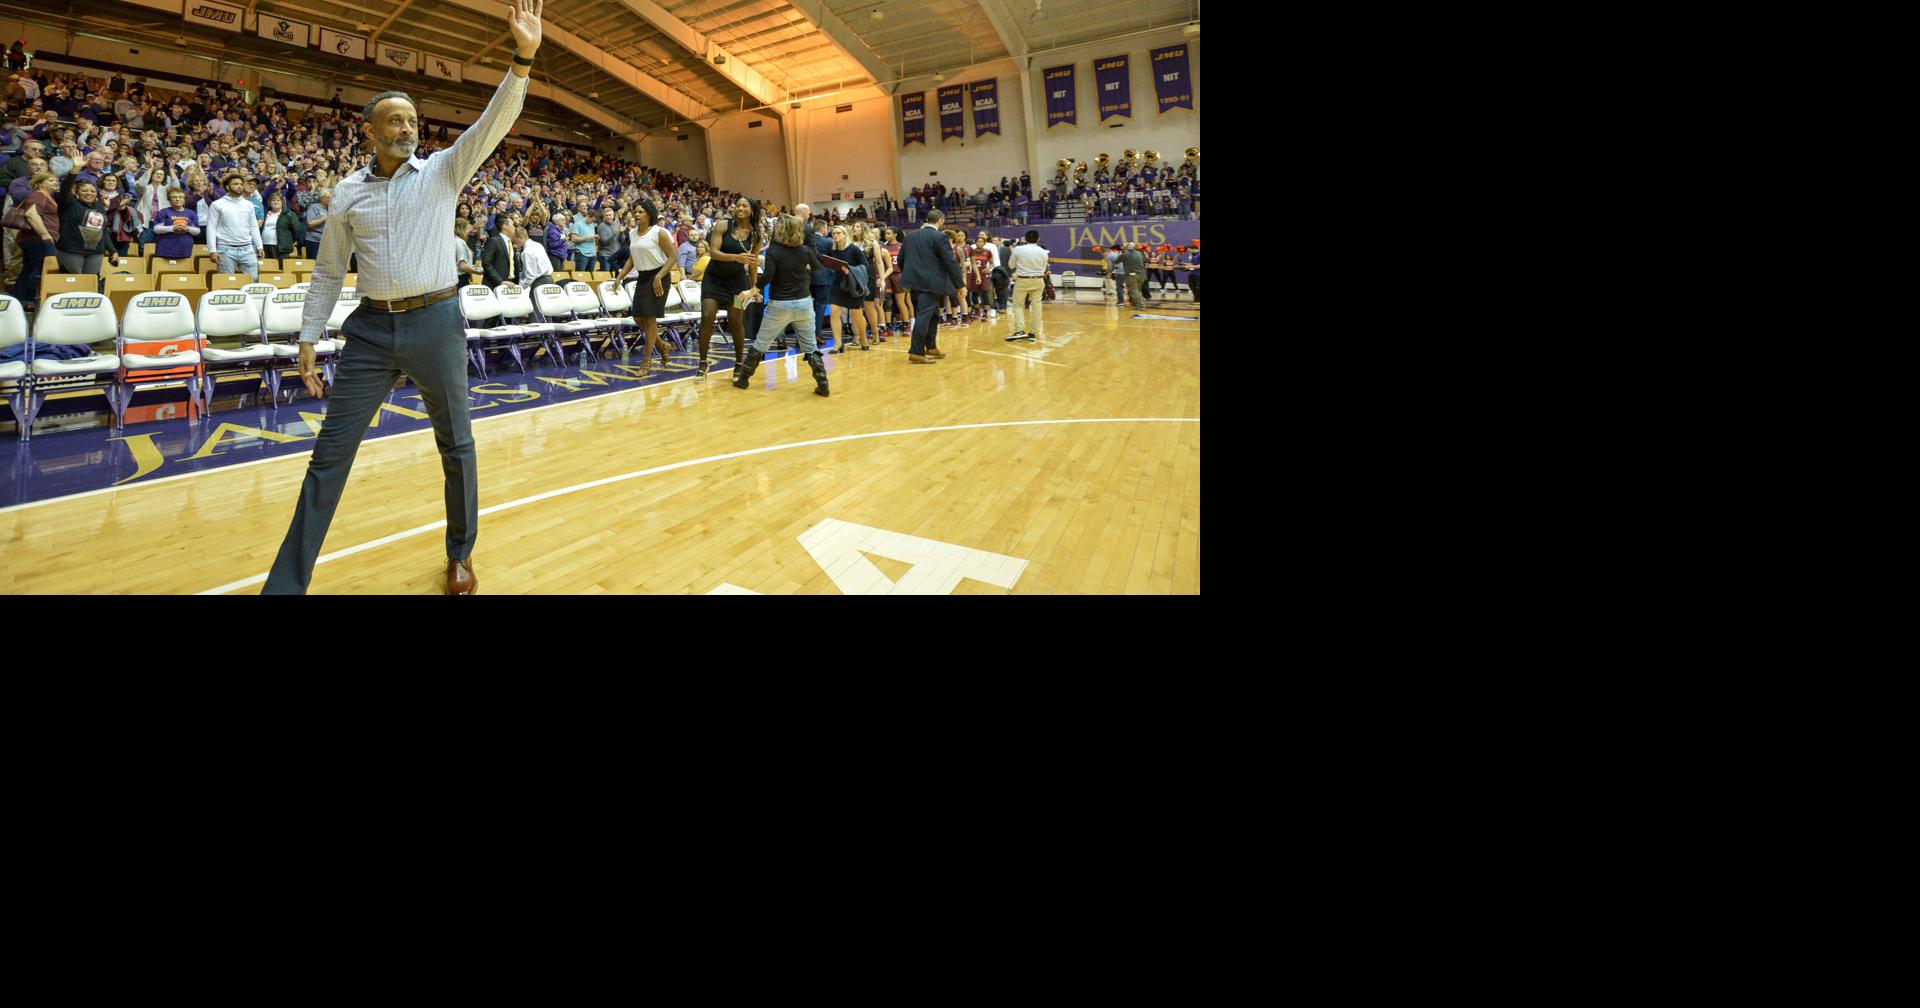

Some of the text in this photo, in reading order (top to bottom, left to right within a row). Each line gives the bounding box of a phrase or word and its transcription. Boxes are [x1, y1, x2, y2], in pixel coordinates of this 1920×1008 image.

[192, 6, 236, 24] JMU
[1163, 72, 1180, 82] NIT
[1105, 82, 1120, 91] NIT
[1053, 90, 1066, 99] NIT
[1066, 224, 1166, 252] JAMES
[467, 288, 489, 296] JMU
[501, 287, 521, 295] JMU
[51, 298, 103, 309] JMU
[137, 296, 181, 307] JMU
[208, 294, 246, 305] JMU
